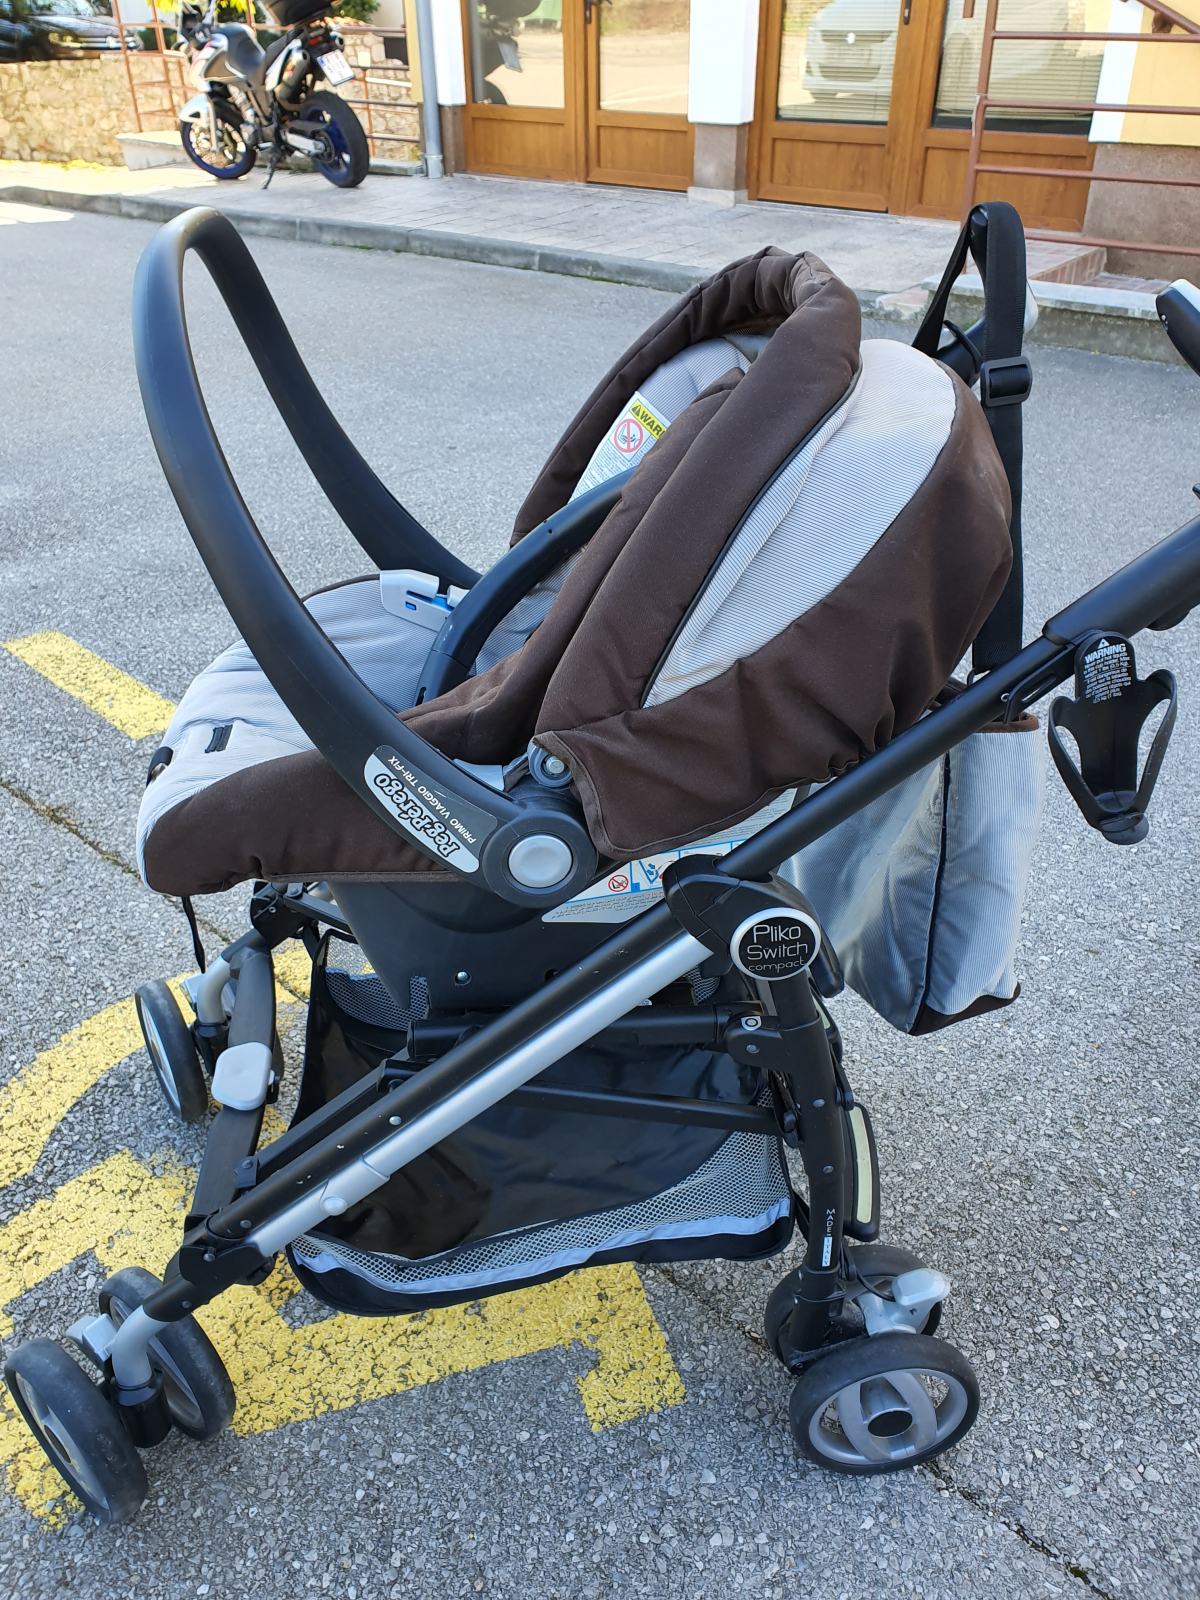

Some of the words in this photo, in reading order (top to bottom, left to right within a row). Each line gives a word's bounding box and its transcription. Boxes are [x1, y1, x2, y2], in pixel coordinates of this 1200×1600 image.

[639, 410, 666, 438] WAR
[1085, 643, 1126, 663] WARNING
[388, 755, 419, 787] TRI-FIX
[417, 786, 450, 819] VIAGGIO
[450, 818, 476, 844] PRIMO
[753, 924, 801, 943] Pliko
[747, 941, 808, 960] Switch
[748, 956, 805, 974] compact
[826, 1208, 835, 1233] MADE
